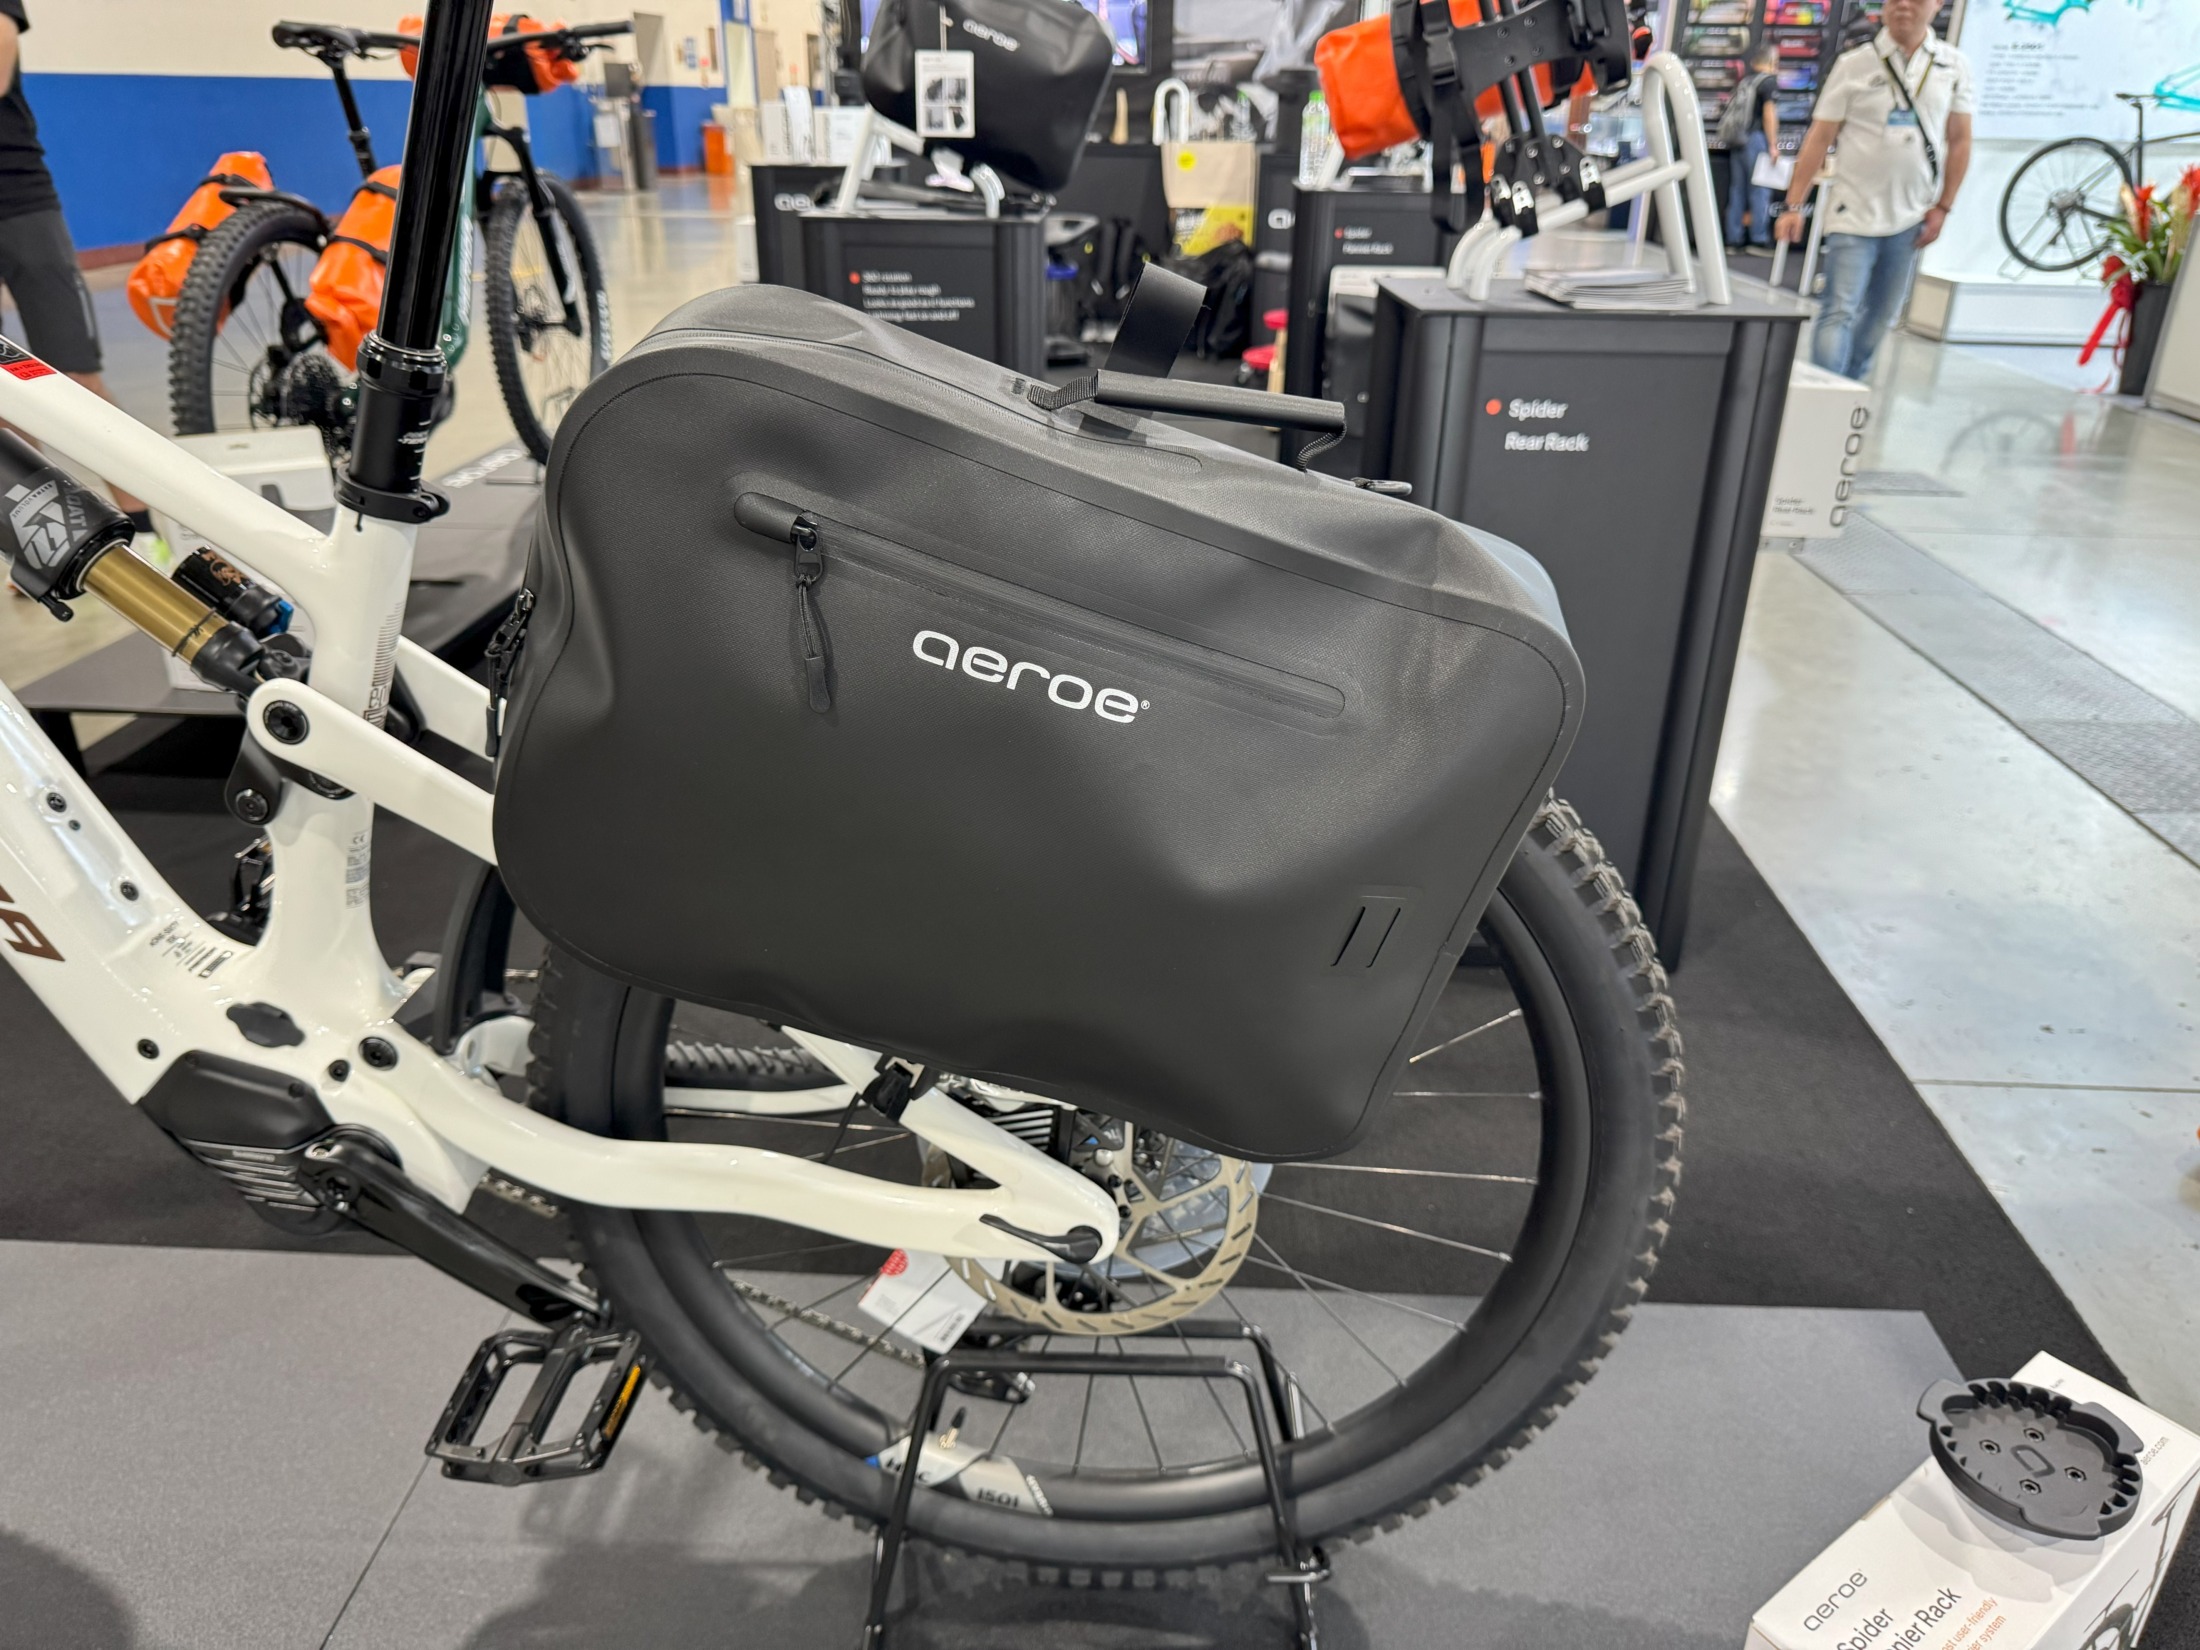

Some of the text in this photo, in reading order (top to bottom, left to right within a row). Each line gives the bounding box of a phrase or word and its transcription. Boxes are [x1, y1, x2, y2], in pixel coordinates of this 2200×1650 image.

[962, 18, 1019, 51] aeroe
[1508, 398, 1568, 421] Spider
[1504, 431, 1590, 451] Rear Rack
[1830, 405, 1869, 527] aeroe
[1803, 1571, 1868, 1632] aeroe
[1914, 1587, 1962, 1628] Rack
[1953, 1597, 1998, 1642] user-friendly
[1979, 1615, 2006, 1641] system
